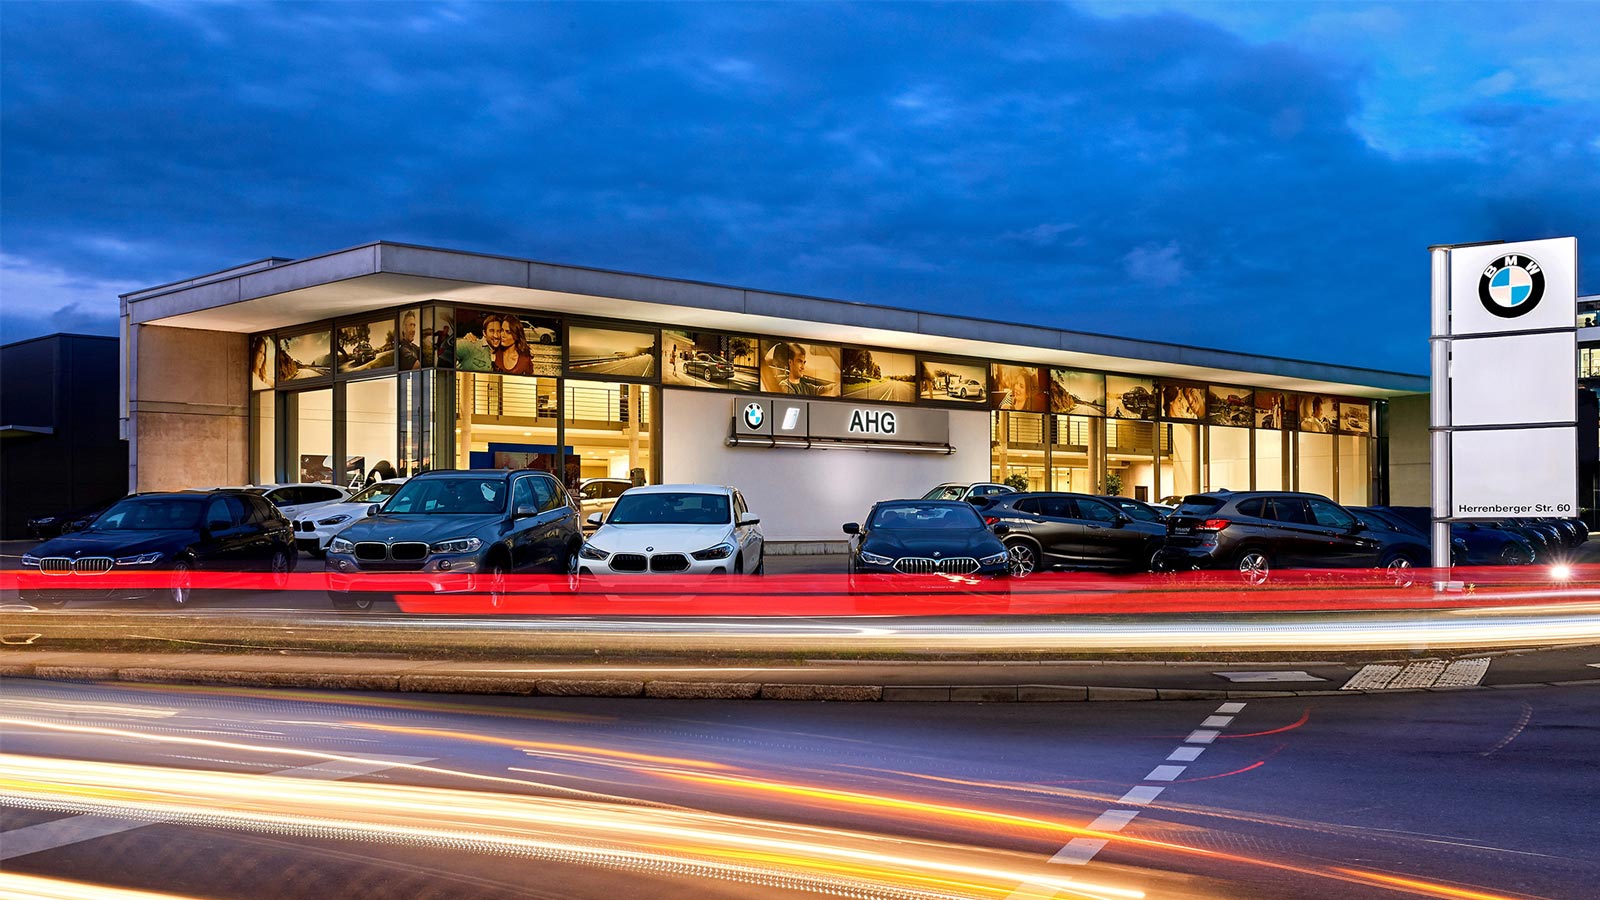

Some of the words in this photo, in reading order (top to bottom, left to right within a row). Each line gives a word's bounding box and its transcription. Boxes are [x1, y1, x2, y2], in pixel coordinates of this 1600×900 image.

[1484, 255, 1541, 278] BMW
[849, 410, 896, 434] AHG
[1459, 504, 1532, 514] Herrenberger
[1535, 503, 1554, 512] Str.
[1557, 503, 1571, 512] 60
